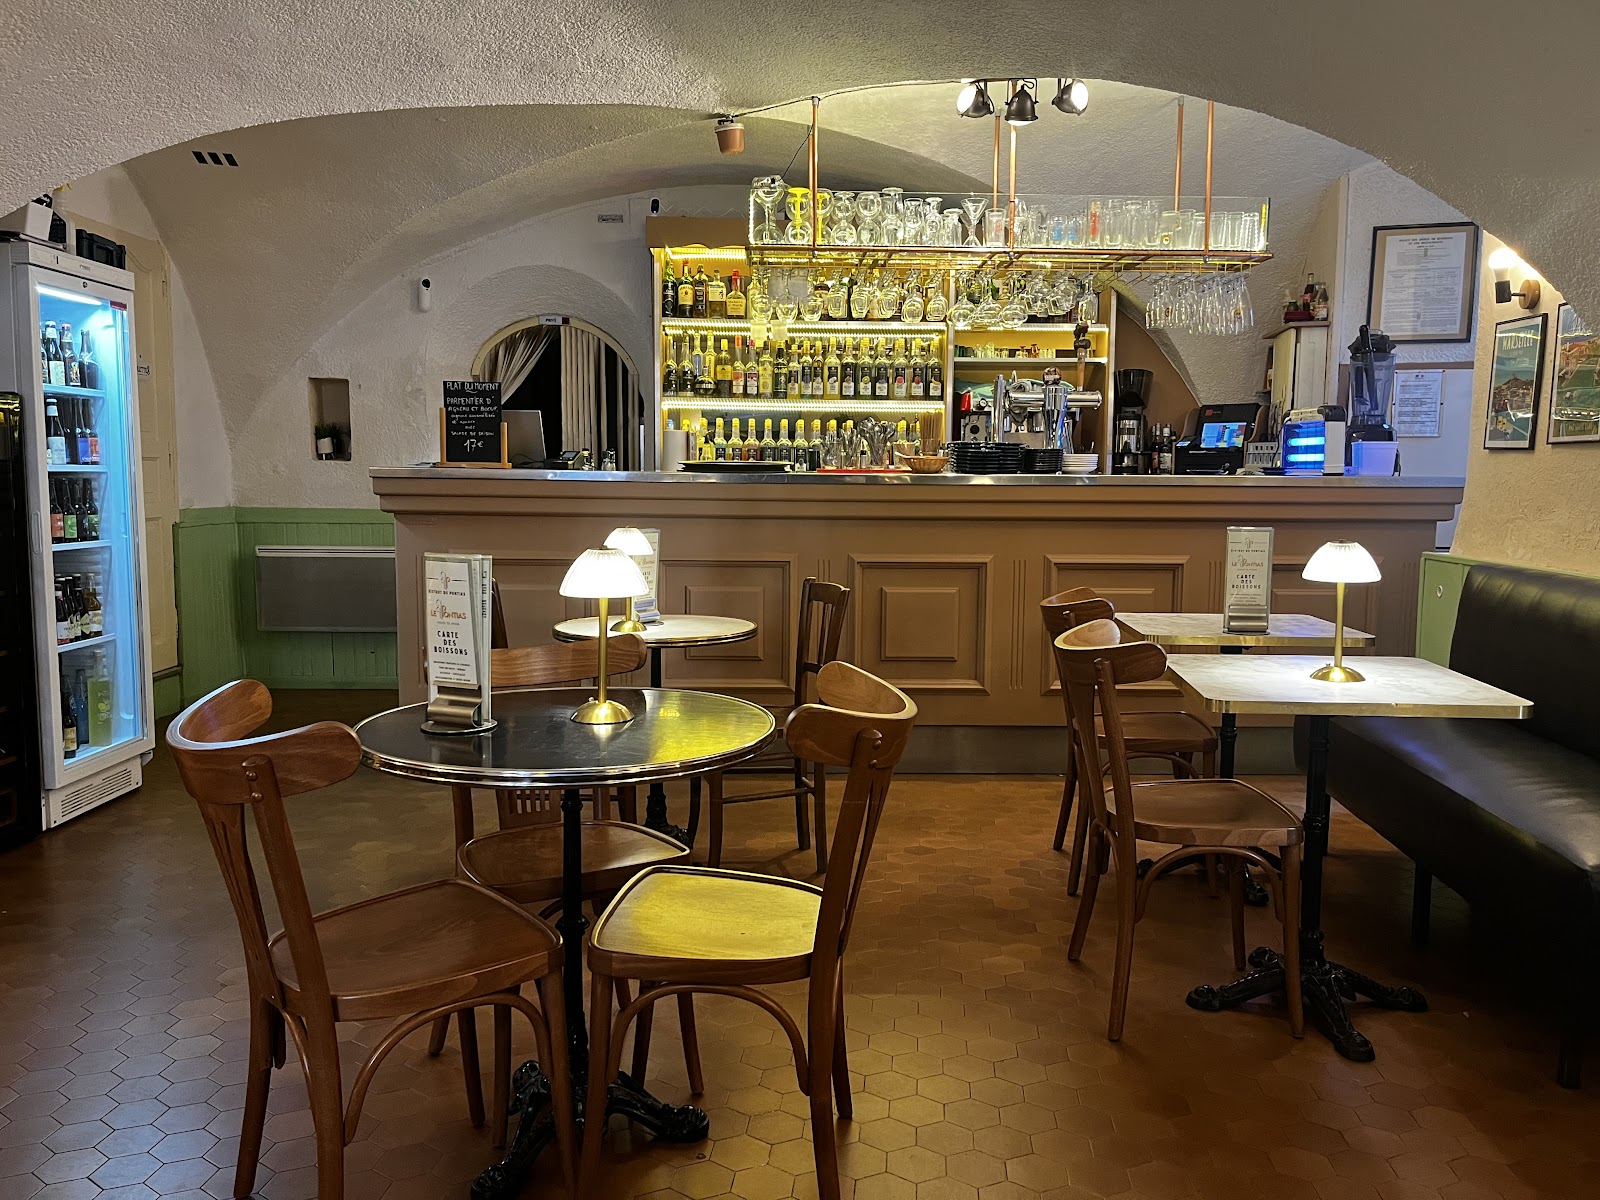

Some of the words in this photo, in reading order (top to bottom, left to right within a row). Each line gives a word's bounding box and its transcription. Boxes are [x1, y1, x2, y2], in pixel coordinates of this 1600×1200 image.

[1502, 329, 1534, 350] MARSEILLE
[446, 381, 462, 391] PLAT
[474, 382, 500, 391] MOMENT
[446, 396, 484, 405] PARMENTIER
[463, 438, 484, 453] 17€
[430, 609, 437, 617] LE
[437, 630, 459, 639] CARTE
[443, 639, 457, 647] DES
[433, 645, 468, 656] BOISSONS
